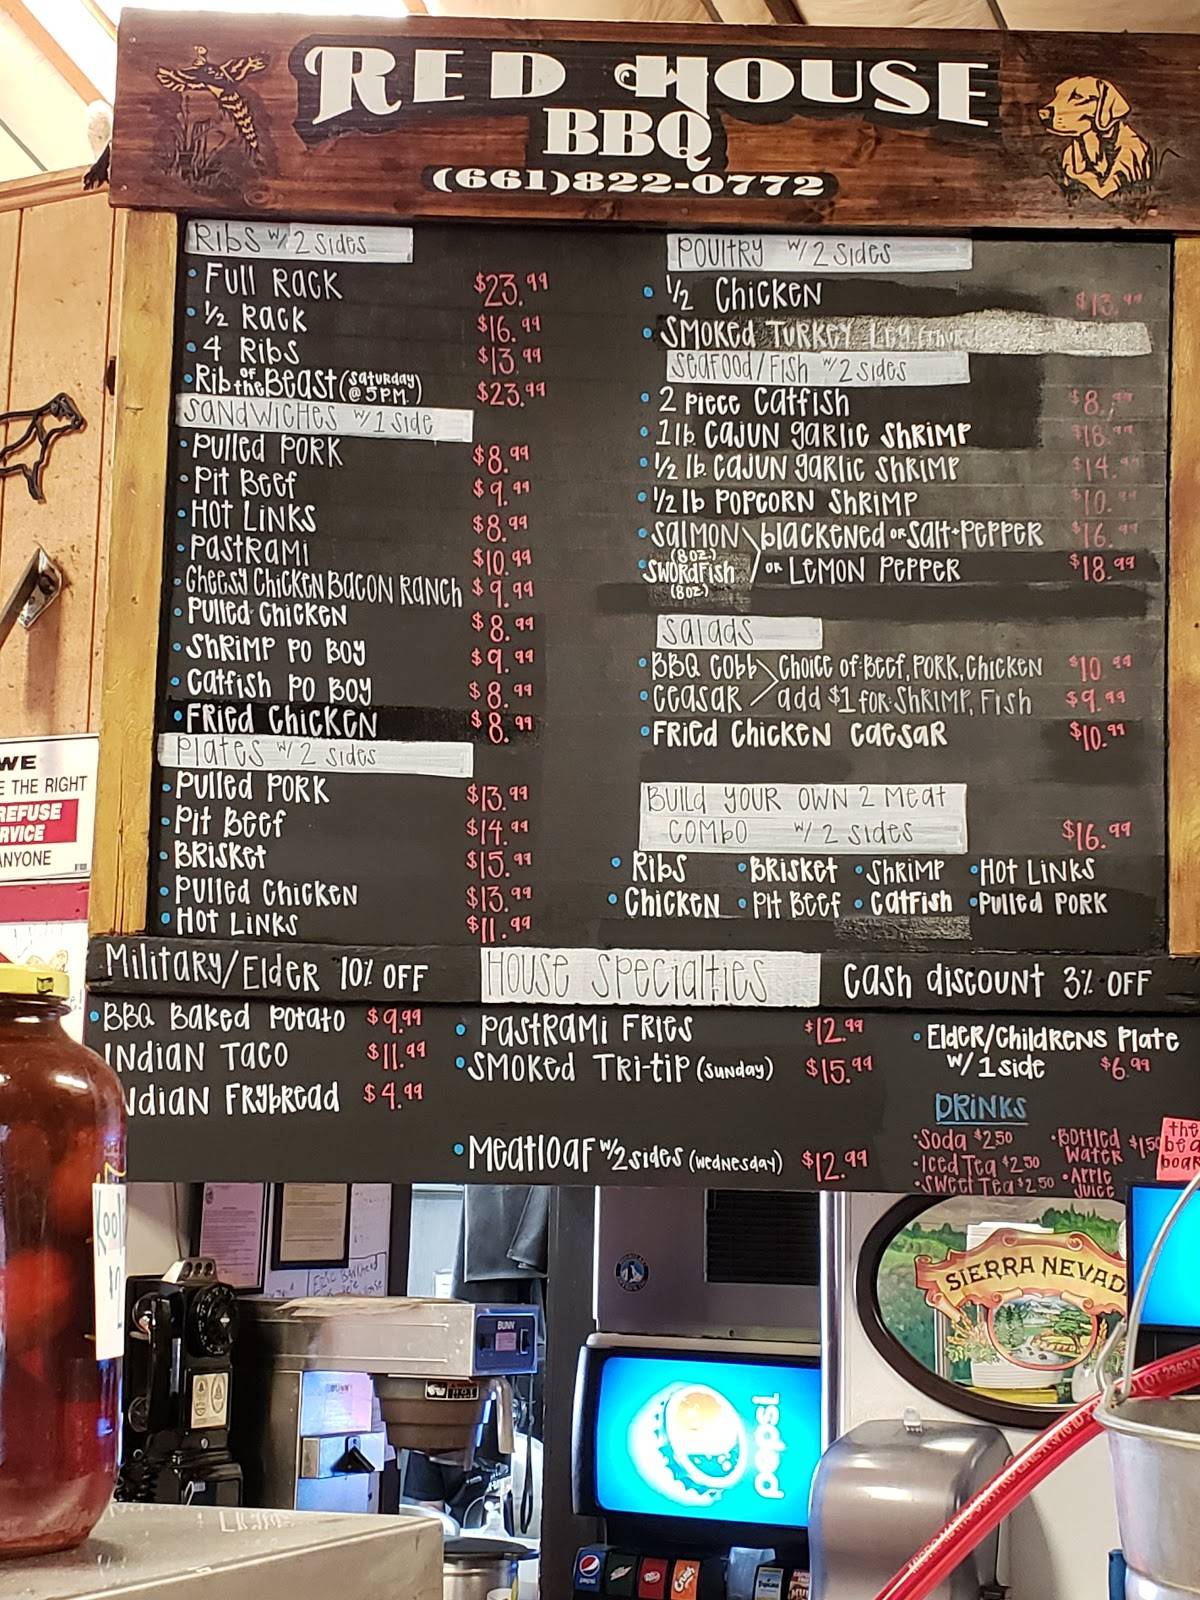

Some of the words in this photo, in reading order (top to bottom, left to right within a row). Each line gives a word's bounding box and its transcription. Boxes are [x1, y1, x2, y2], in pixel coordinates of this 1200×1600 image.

[304, 46, 566, 125] RED
[614, 55, 989, 127] HOUSE
[542, 107, 712, 171] BBQ
[432, 168, 825, 196] (661)822-0772
[202, 340, 222, 361] 4
[652, 651, 701, 681] BBQ
[12, 779, 38, 795] THE
[45, 776, 88, 793] RIGHT
[860, 786, 874, 807] 2
[340, 958, 373, 990] 10%
[383, 965, 428, 992] OFF
[1063, 966, 1094, 999] 3%
[1107, 970, 1152, 997] OFF
[104, 1002, 154, 1032] BBQ
[945, 1256, 1036, 1291] SIERRA
[1041, 1256, 1127, 1293] NEVAD
